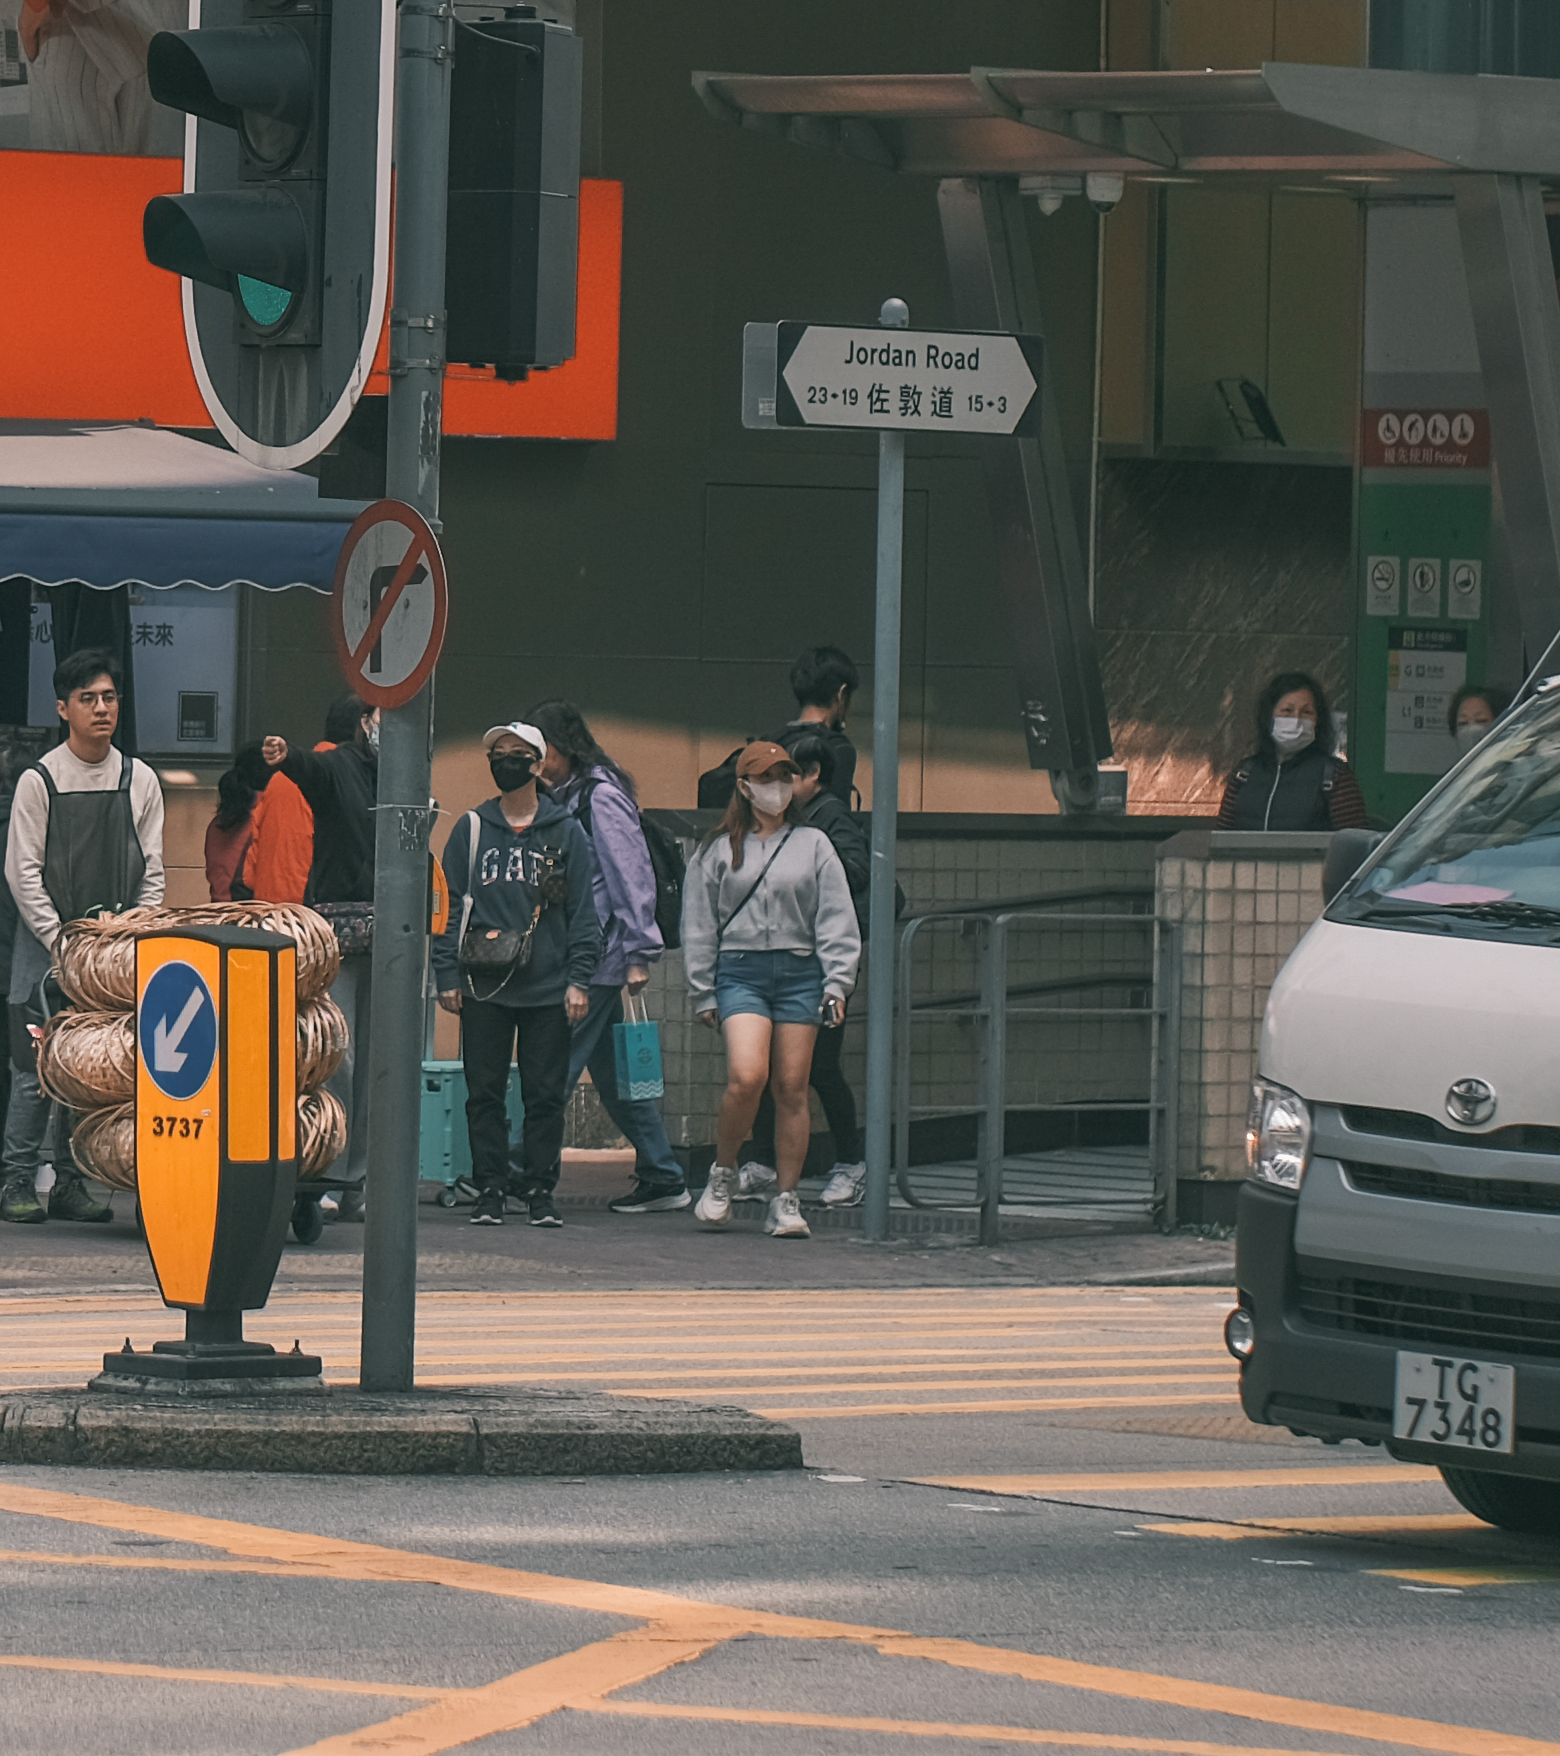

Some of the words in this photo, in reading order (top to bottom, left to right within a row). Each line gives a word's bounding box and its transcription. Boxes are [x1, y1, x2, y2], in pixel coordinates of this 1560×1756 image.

[844, 340, 916, 367] Jordan
[926, 344, 980, 371] Road
[867, 382, 954, 419] 佐敦道
[152, 1116, 204, 1139] 3737
[1432, 1357, 1479, 1405] TG
[1405, 1398, 1501, 1450] 7348
